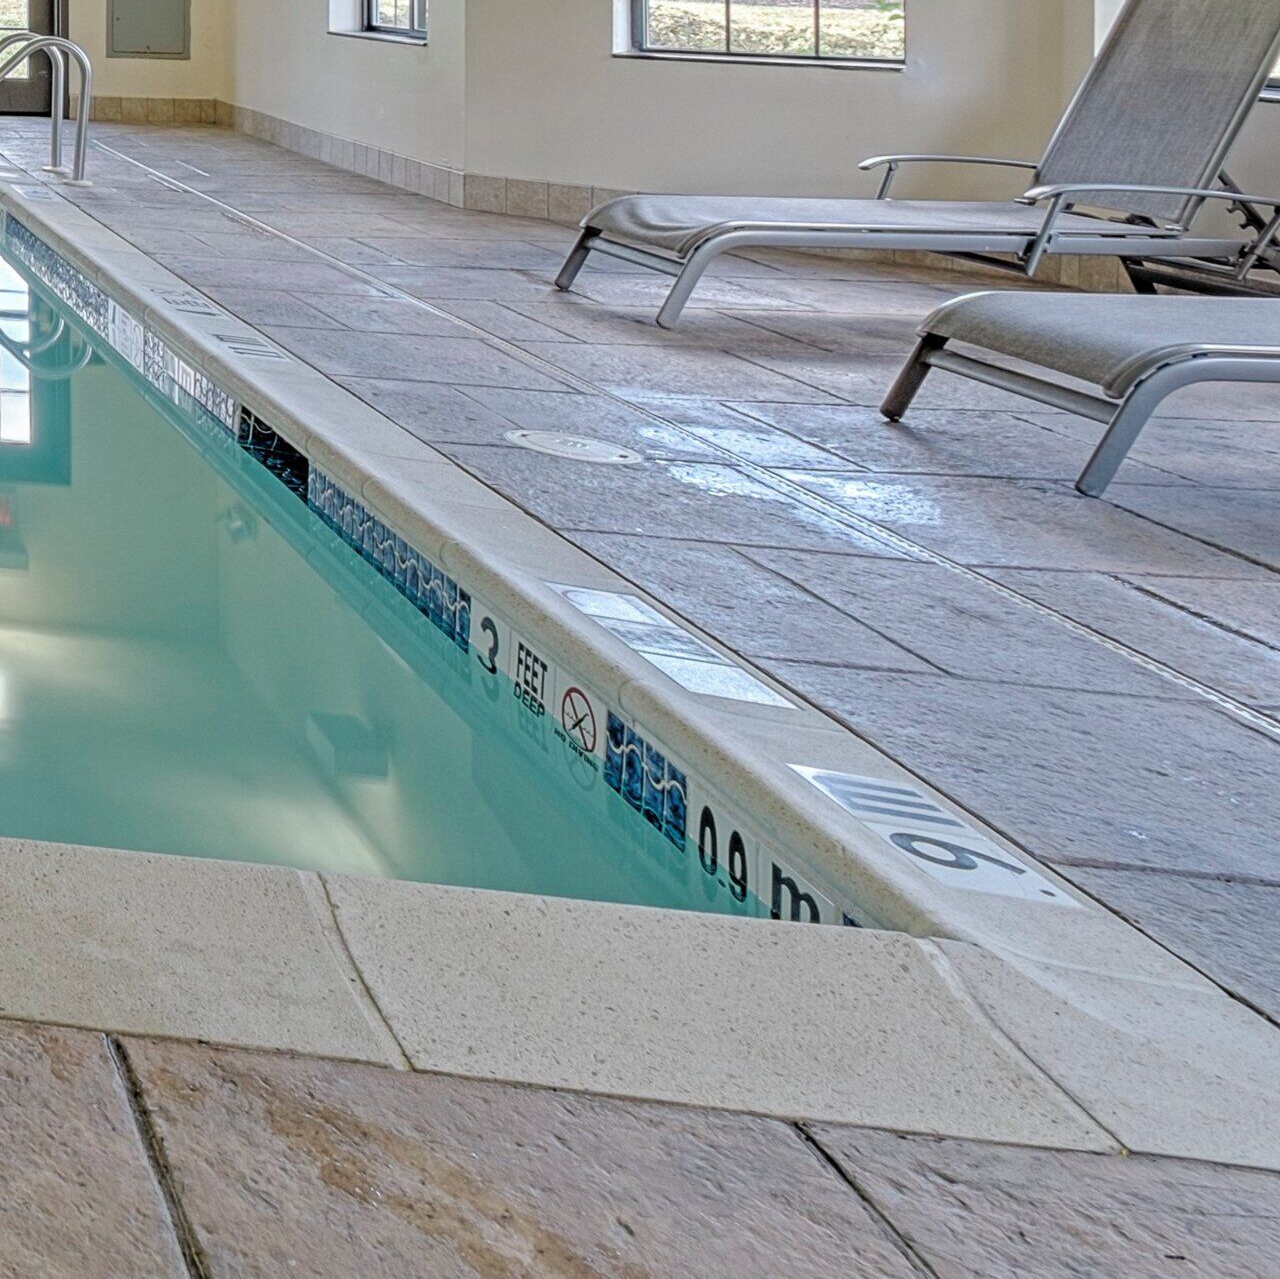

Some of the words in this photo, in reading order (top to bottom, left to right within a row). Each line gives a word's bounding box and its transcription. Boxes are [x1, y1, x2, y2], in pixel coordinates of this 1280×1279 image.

[477, 617, 498, 675] 3
[517, 641, 548, 700] FEET
[514, 680, 545, 718] DEEP
[770, 861, 821, 924] m
